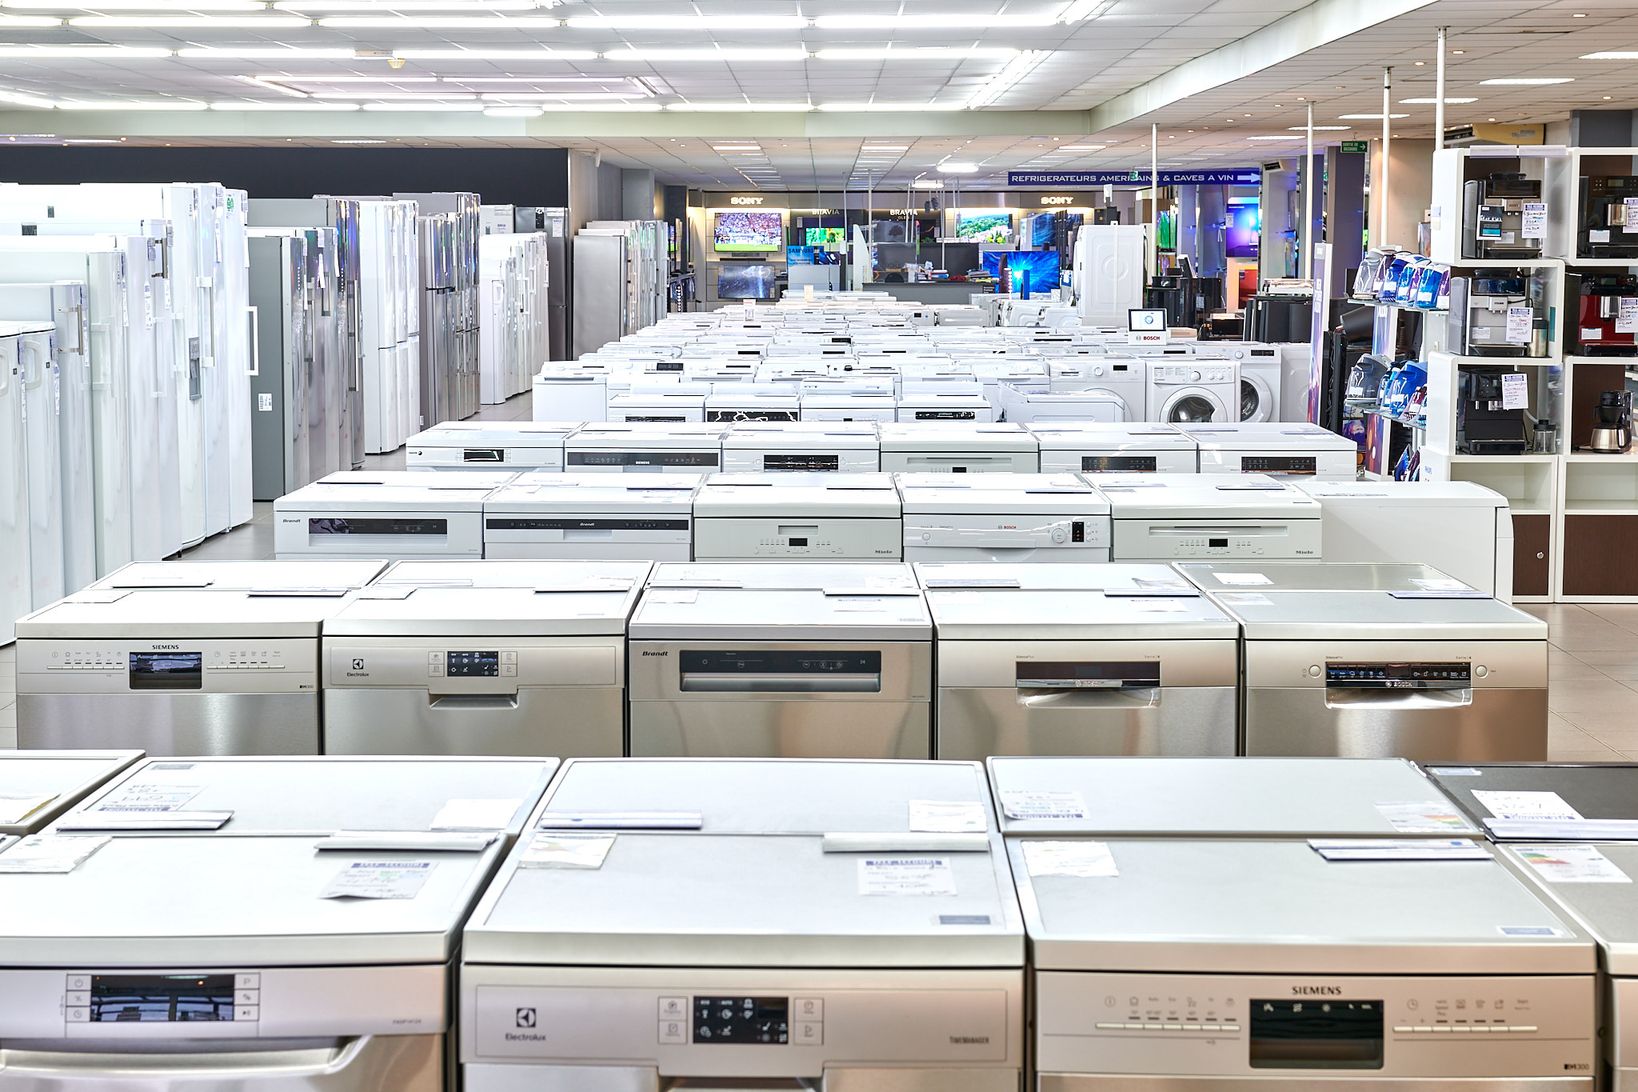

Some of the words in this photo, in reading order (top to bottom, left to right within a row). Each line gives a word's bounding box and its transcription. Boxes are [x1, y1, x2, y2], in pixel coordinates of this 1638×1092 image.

[730, 197, 763, 205] SONY
[1040, 196, 1074, 204] SONY
[1291, 986, 1342, 995] SIEMENS
[505, 1032, 547, 1041] Electrolux
